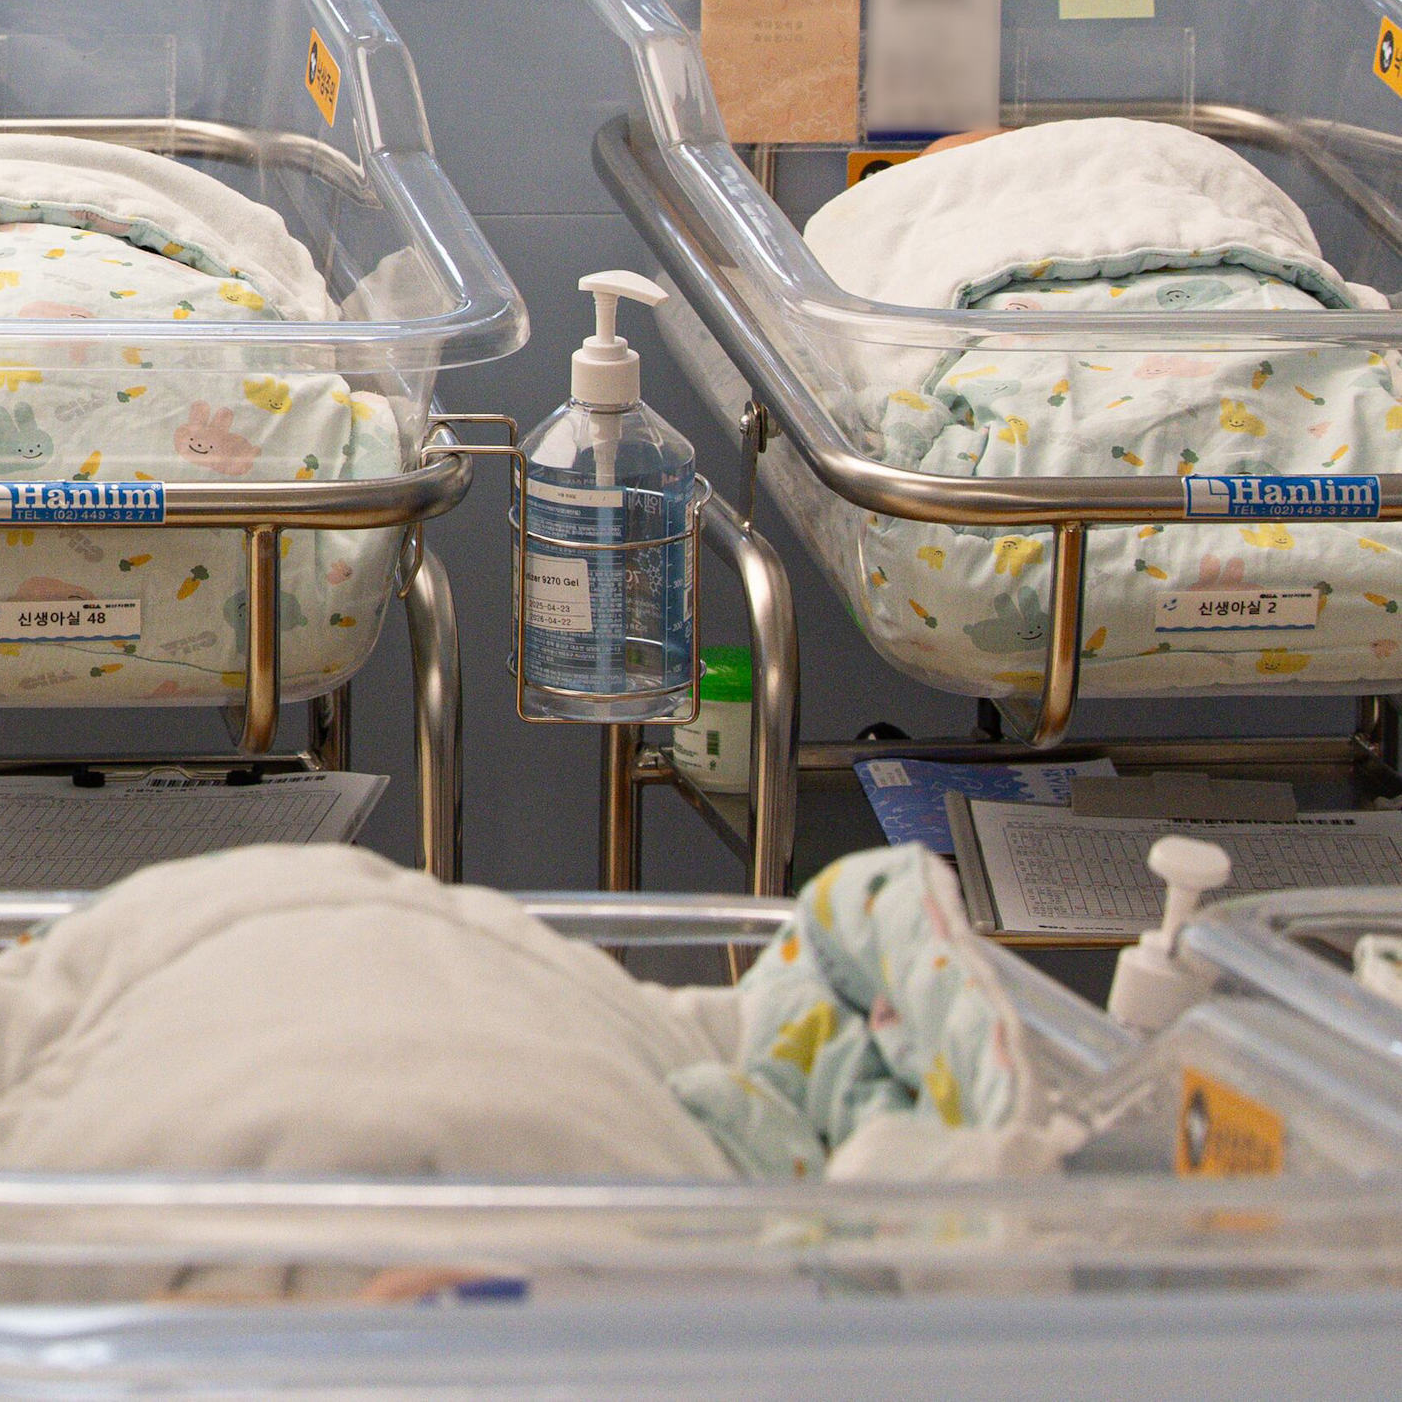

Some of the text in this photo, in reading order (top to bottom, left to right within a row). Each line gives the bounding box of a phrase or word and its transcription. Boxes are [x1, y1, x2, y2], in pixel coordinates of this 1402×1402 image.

[14, 484, 160, 509] Hanlim
[1230, 479, 1375, 505] Hanlim
[53, 510, 78, 520] (02)
[1269, 505, 1294, 516] (02)
[542, 575, 560, 585] 9270
[564, 578, 579, 587] Gel
[1198, 601, 1277, 616] 신생아실 2
[18, 611, 106, 627] 신생아실 48
